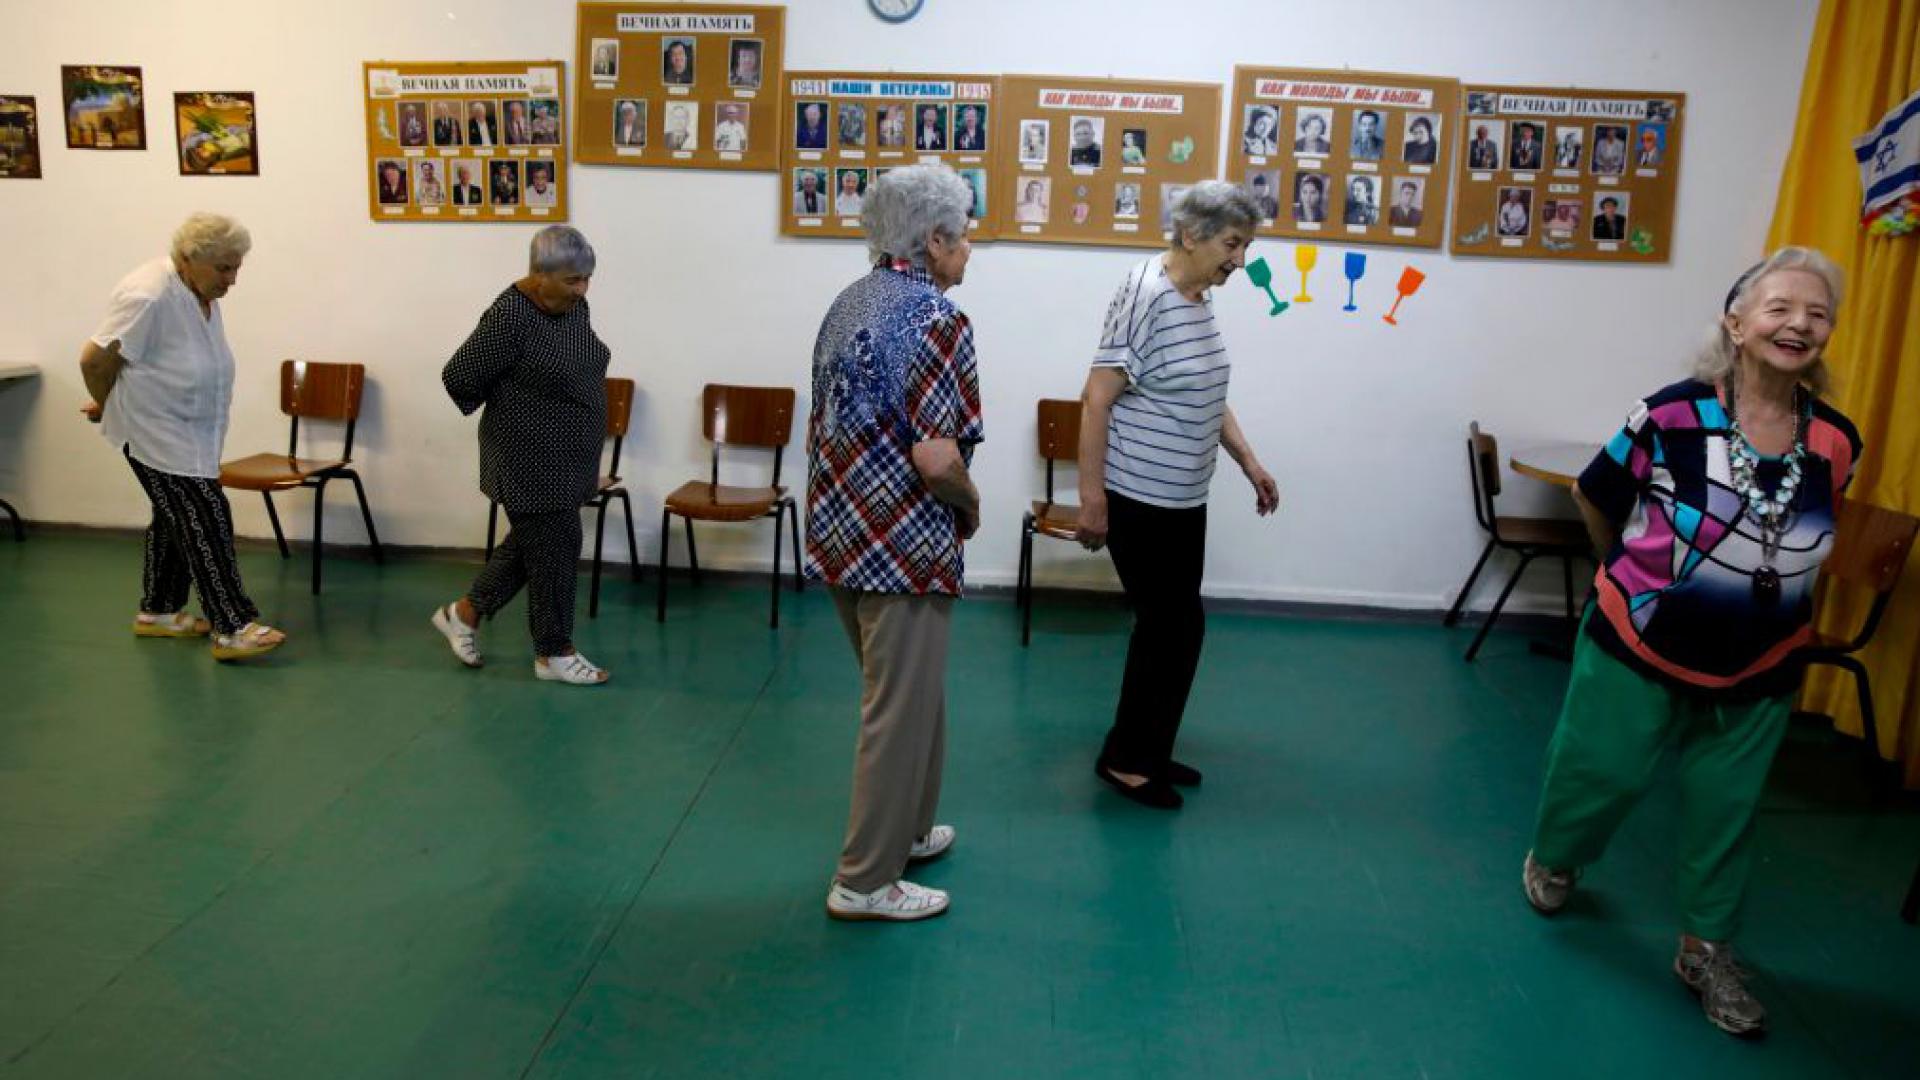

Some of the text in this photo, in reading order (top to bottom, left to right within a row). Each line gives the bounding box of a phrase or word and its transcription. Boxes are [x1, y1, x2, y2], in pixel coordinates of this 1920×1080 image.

[621, 16, 752, 30] ВЕЧНАЯ ПАМЯТЬ
[401, 79, 527, 90] ВЕЧНАЯ ПАМЯТЬ
[831, 81, 872, 94] НАШИ
[880, 82, 951, 96] ВЕТЕРАНЫ
[1261, 82, 1288, 95] КАК
[1290, 84, 1350, 100] МОЛОДЫ
[1353, 88, 1380, 101] МЫ
[1043, 92, 1066, 105] КАК
[1067, 94, 1117, 108] МОЛОДЫ
[1119, 97, 1142, 108] МЫ
[1503, 98, 1645, 116] ВЕЧНАЯ ПАМЯТЬ
